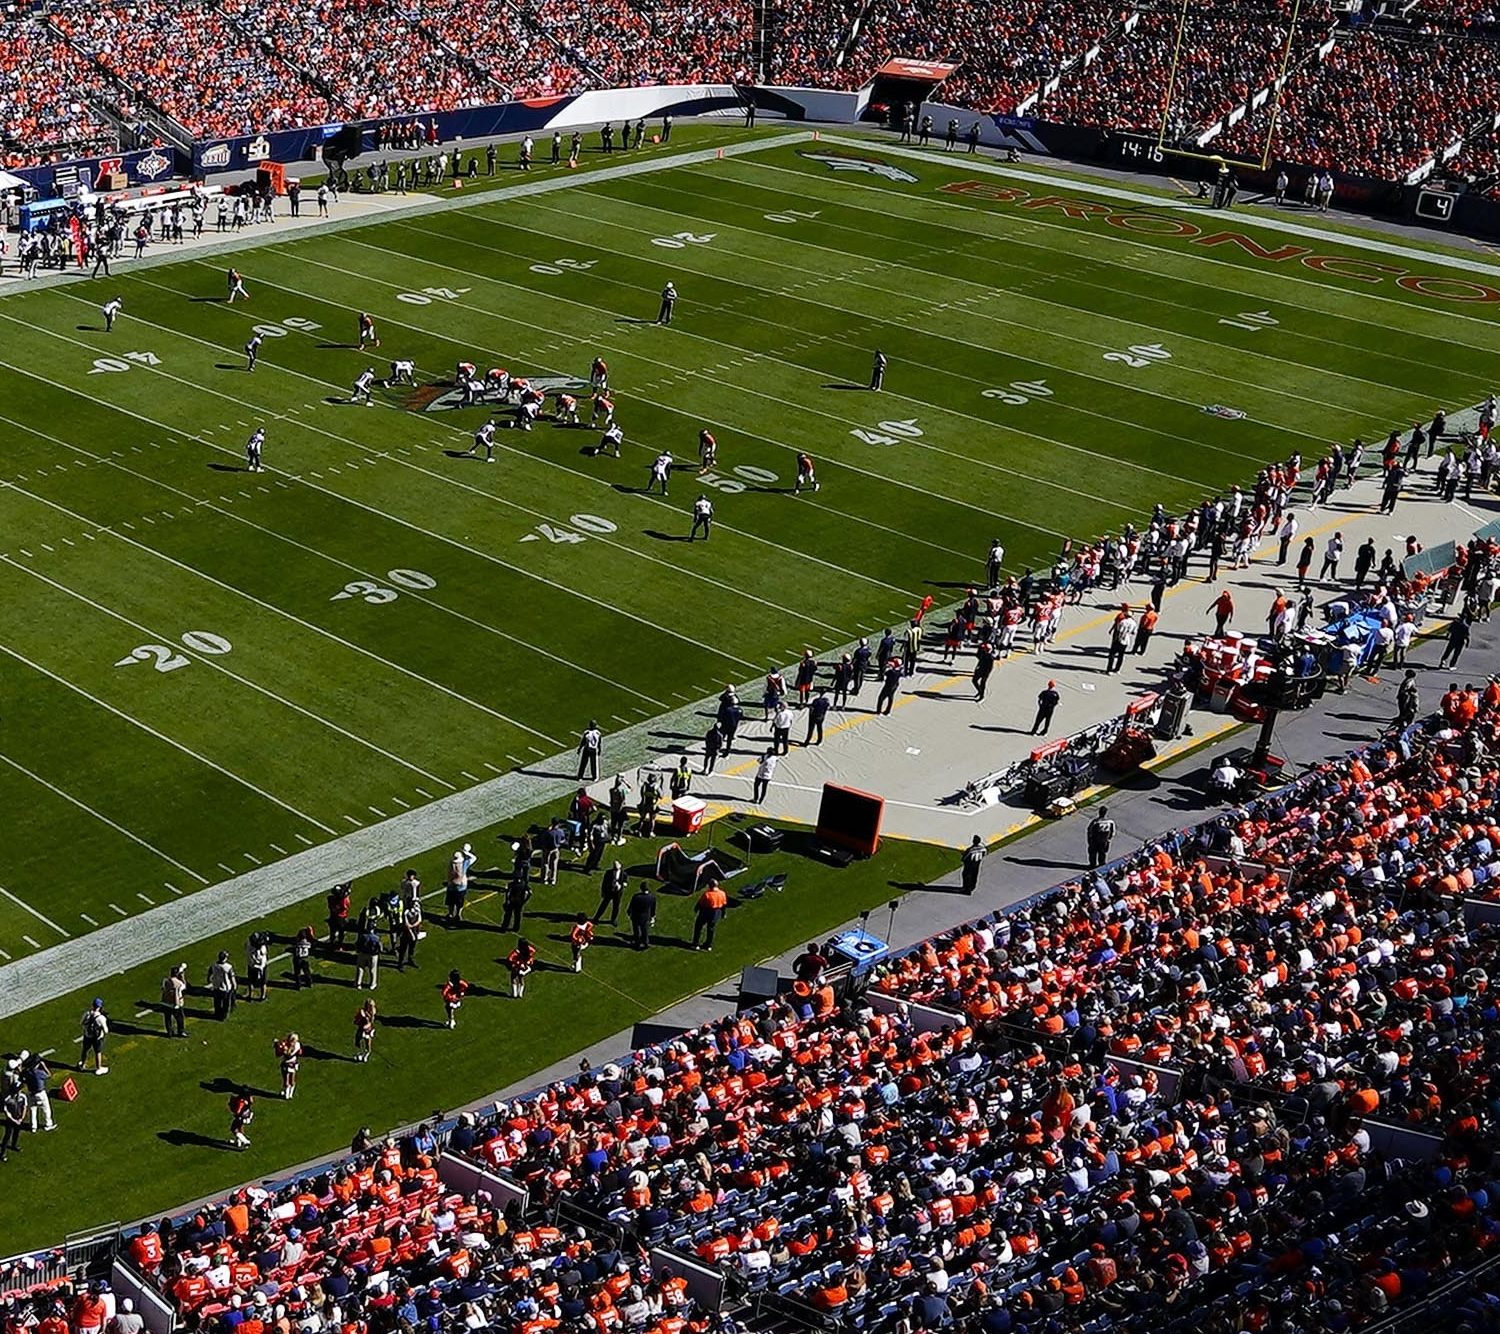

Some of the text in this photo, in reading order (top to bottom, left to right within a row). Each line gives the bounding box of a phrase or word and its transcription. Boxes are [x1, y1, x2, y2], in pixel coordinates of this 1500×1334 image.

[893, 57, 955, 70] GEICO
[1121, 140, 1164, 164] 14:16
[1436, 198, 1449, 215] 4
[397, 285, 458, 307] 40
[103, 350, 163, 375] 40
[1103, 344, 1165, 369] 20
[981, 380, 1050, 407] 30
[851, 419, 926, 446] 40
[698, 464, 780, 495] 50
[534, 513, 619, 546] 40
[347, 568, 438, 605] 30
[131, 629, 233, 673] 20
